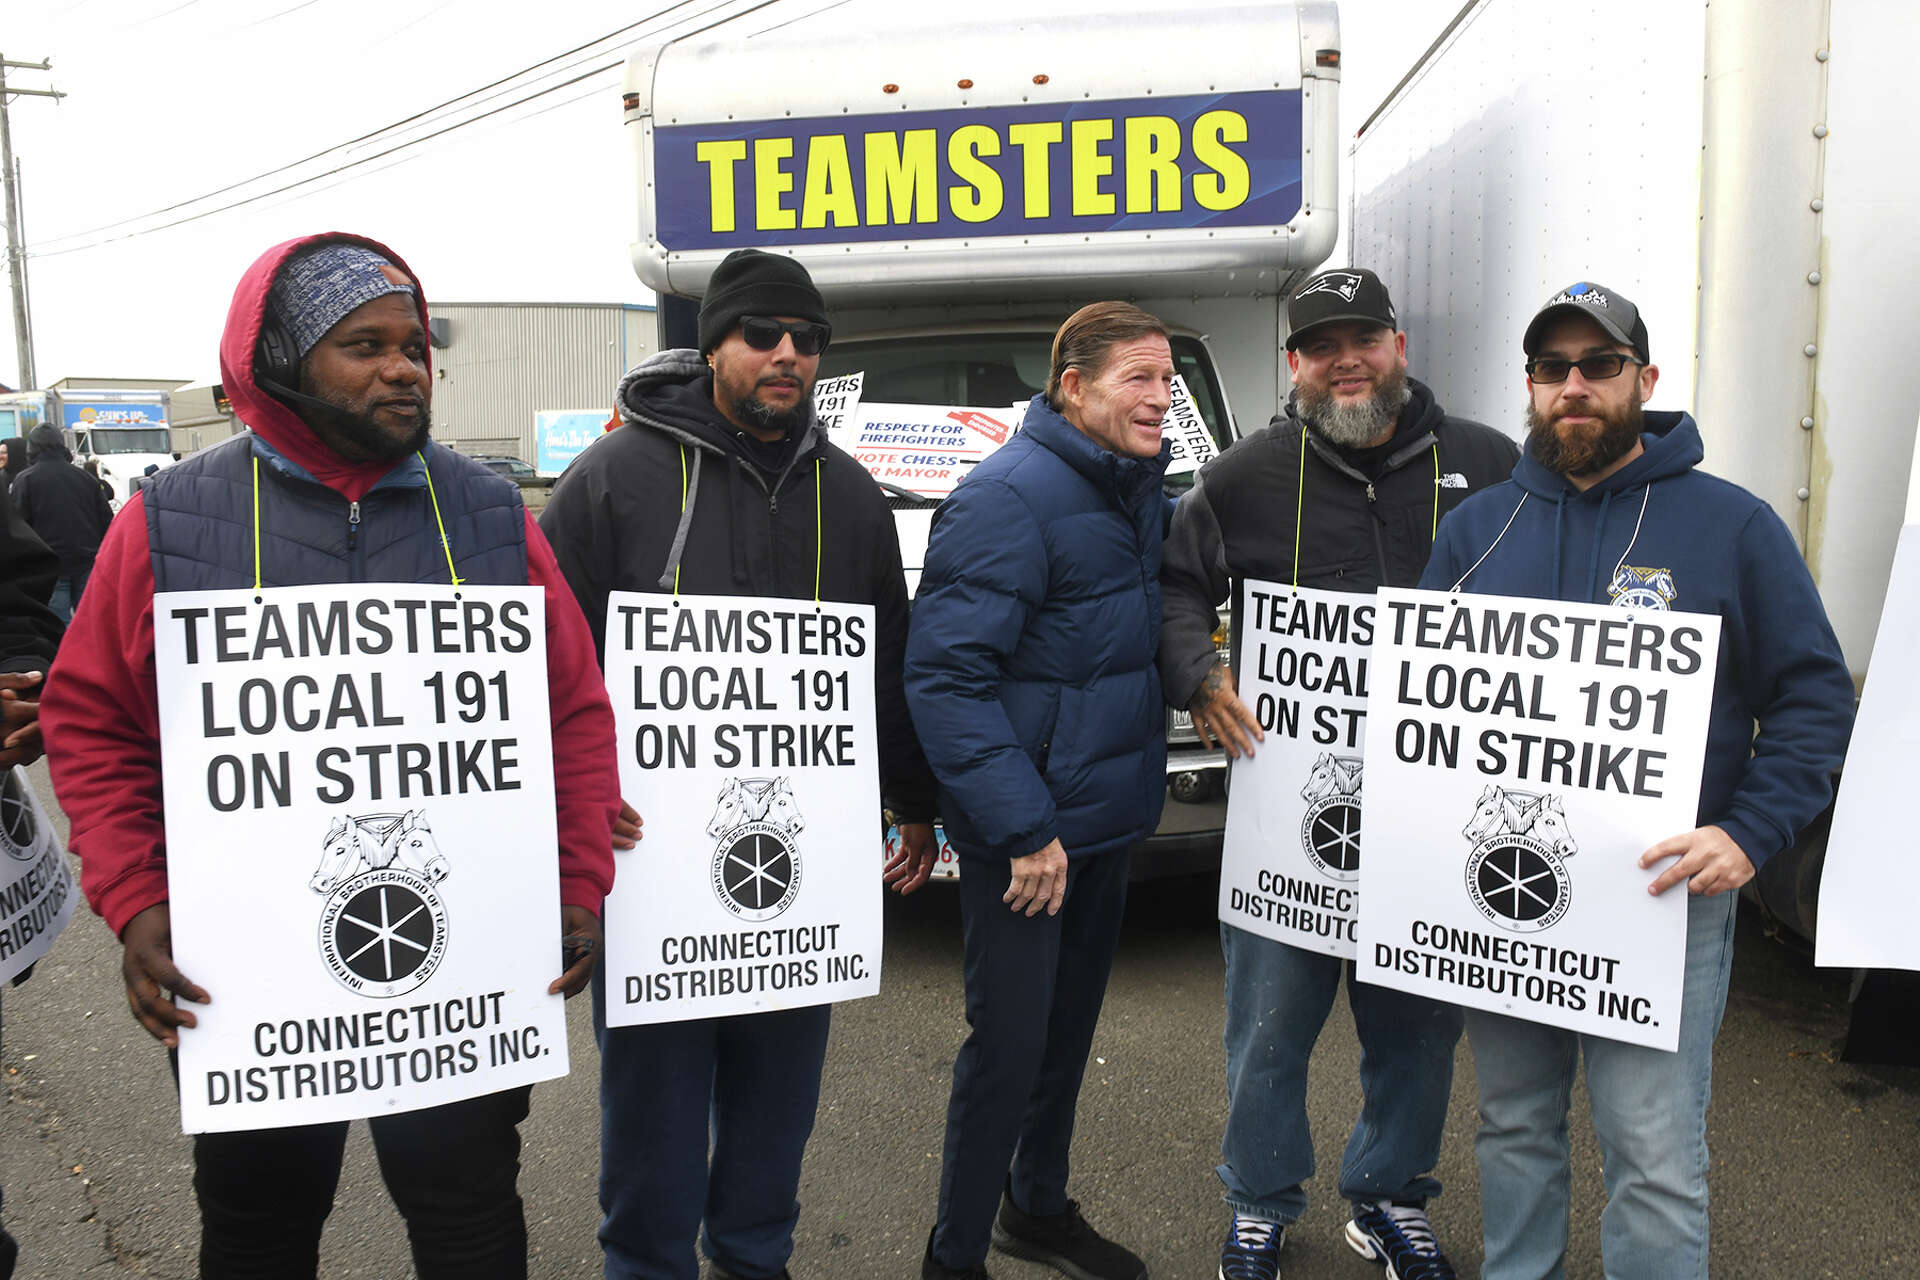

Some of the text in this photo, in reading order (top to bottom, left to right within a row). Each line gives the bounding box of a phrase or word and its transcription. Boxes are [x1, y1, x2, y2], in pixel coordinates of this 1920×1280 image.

[696, 110, 1249, 233] TEAMSTERS
[818, 396, 846, 411] 191
[821, 414, 844, 429] KE
[864, 421, 964, 434] RESPECT FOR
[853, 453, 958, 466] VOTE CHESS
[859, 434, 966, 447] FIREFIGHTERS
[884, 467, 951, 479] MAYOR
[172, 600, 531, 664] TEAMSTERS
[617, 606, 866, 657] TEAMSTERS
[1251, 592, 1375, 645] TEAMS
[1388, 601, 1702, 675] TEAMSTERS
[634, 665, 849, 711] LOCAL 191
[1258, 643, 1368, 697] LOCAL
[202, 671, 510, 738] LOCAL 191
[1256, 693, 1367, 748] ON ST
[1398, 661, 1668, 735] LOCAL 191
[635, 724, 855, 769] ON STRIKE
[1395, 719, 1665, 798] ON STRIKE
[207, 738, 521, 811] ON STRIKE
[1468, 850, 1496, 919] INTERNATIONAL
[1485, 837, 1555, 864] BROTHERHOOD
[1537, 880, 1569, 927] TEAMSTERS
[322, 872, 446, 990] INTERNATIONAL BROTHERHOOD OF TEAMSTERS
[661, 924, 840, 965] CONNECTICUT
[1411, 920, 1620, 984] CONNECTICUT
[625, 954, 869, 1004] DISTRIBUTORS INC.
[1374, 943, 1660, 1027] DISTRIBUTORS INC.
[255, 993, 505, 1057] CONNECTICUT
[207, 1028, 550, 1105] DISTRIBUTORS INC.
